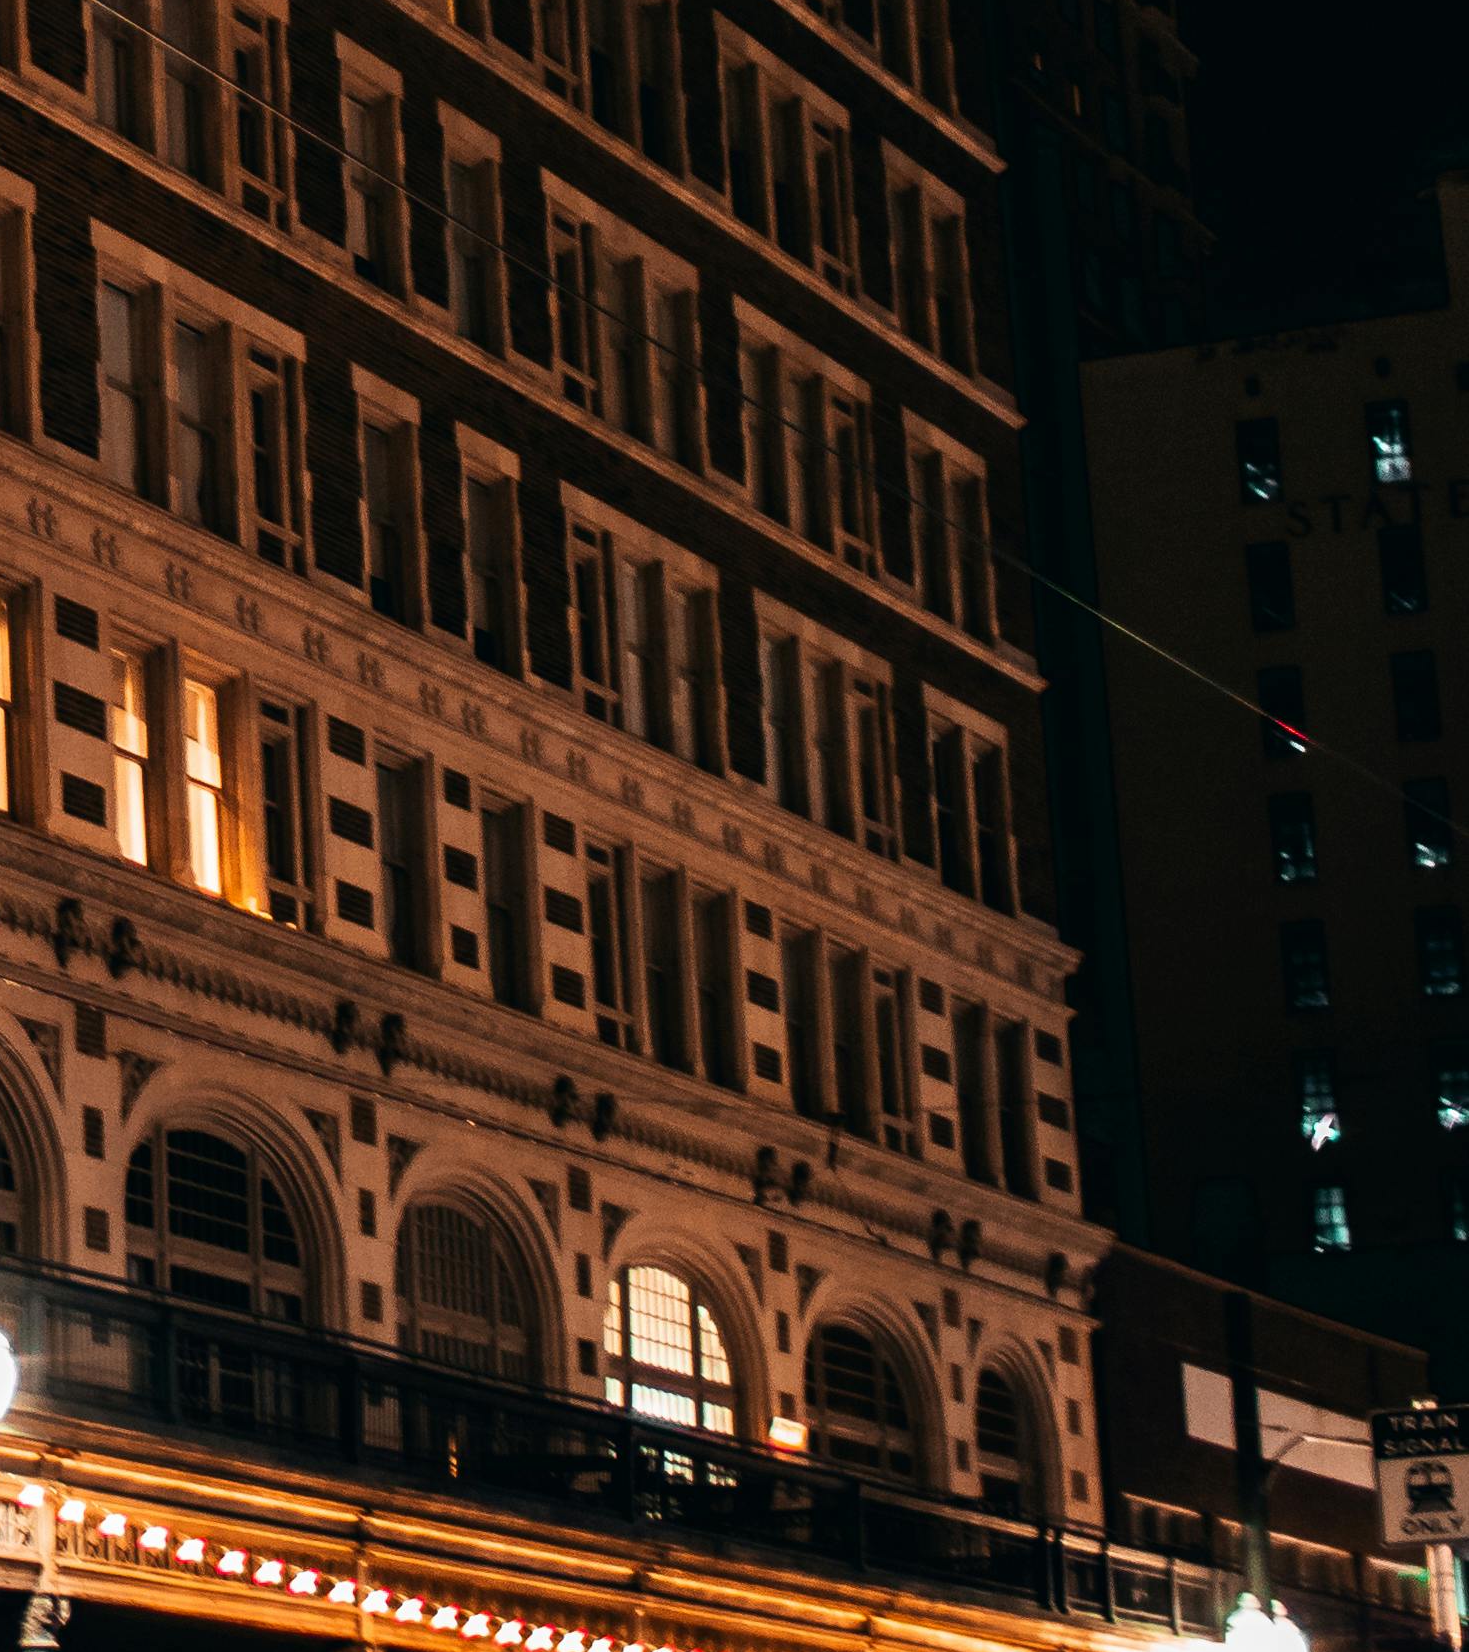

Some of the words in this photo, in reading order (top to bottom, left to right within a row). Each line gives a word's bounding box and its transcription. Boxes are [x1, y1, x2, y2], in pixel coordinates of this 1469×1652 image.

[1388, 1414, 1460, 1432] TRAIN
[1383, 1436, 1469, 1455] SIGNAL
[1402, 1516, 1464, 1535] ONLY
